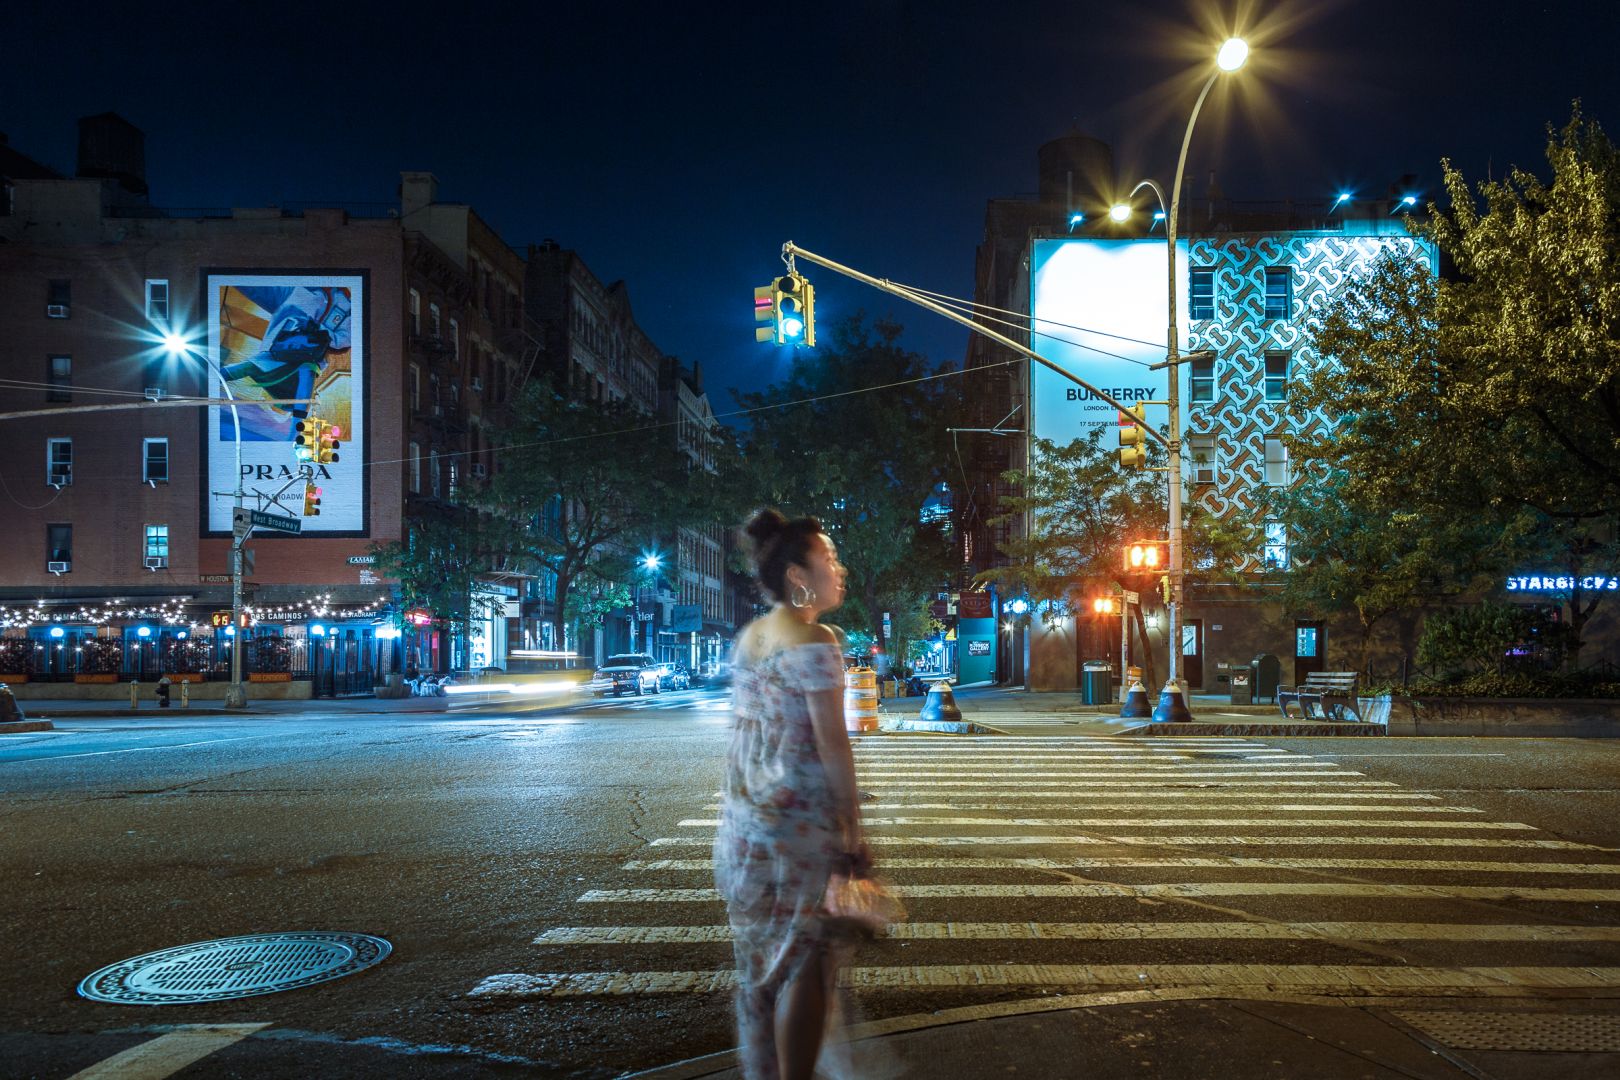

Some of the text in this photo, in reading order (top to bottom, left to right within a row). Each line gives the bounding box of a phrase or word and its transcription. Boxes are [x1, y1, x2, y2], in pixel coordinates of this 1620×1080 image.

[1066, 388, 1156, 401] BURBERRY
[240, 464, 332, 480] PRADA
[253, 514, 266, 524] West
[268, 517, 299, 531] Broadway
[268, 612, 302, 620] CAMINOS
